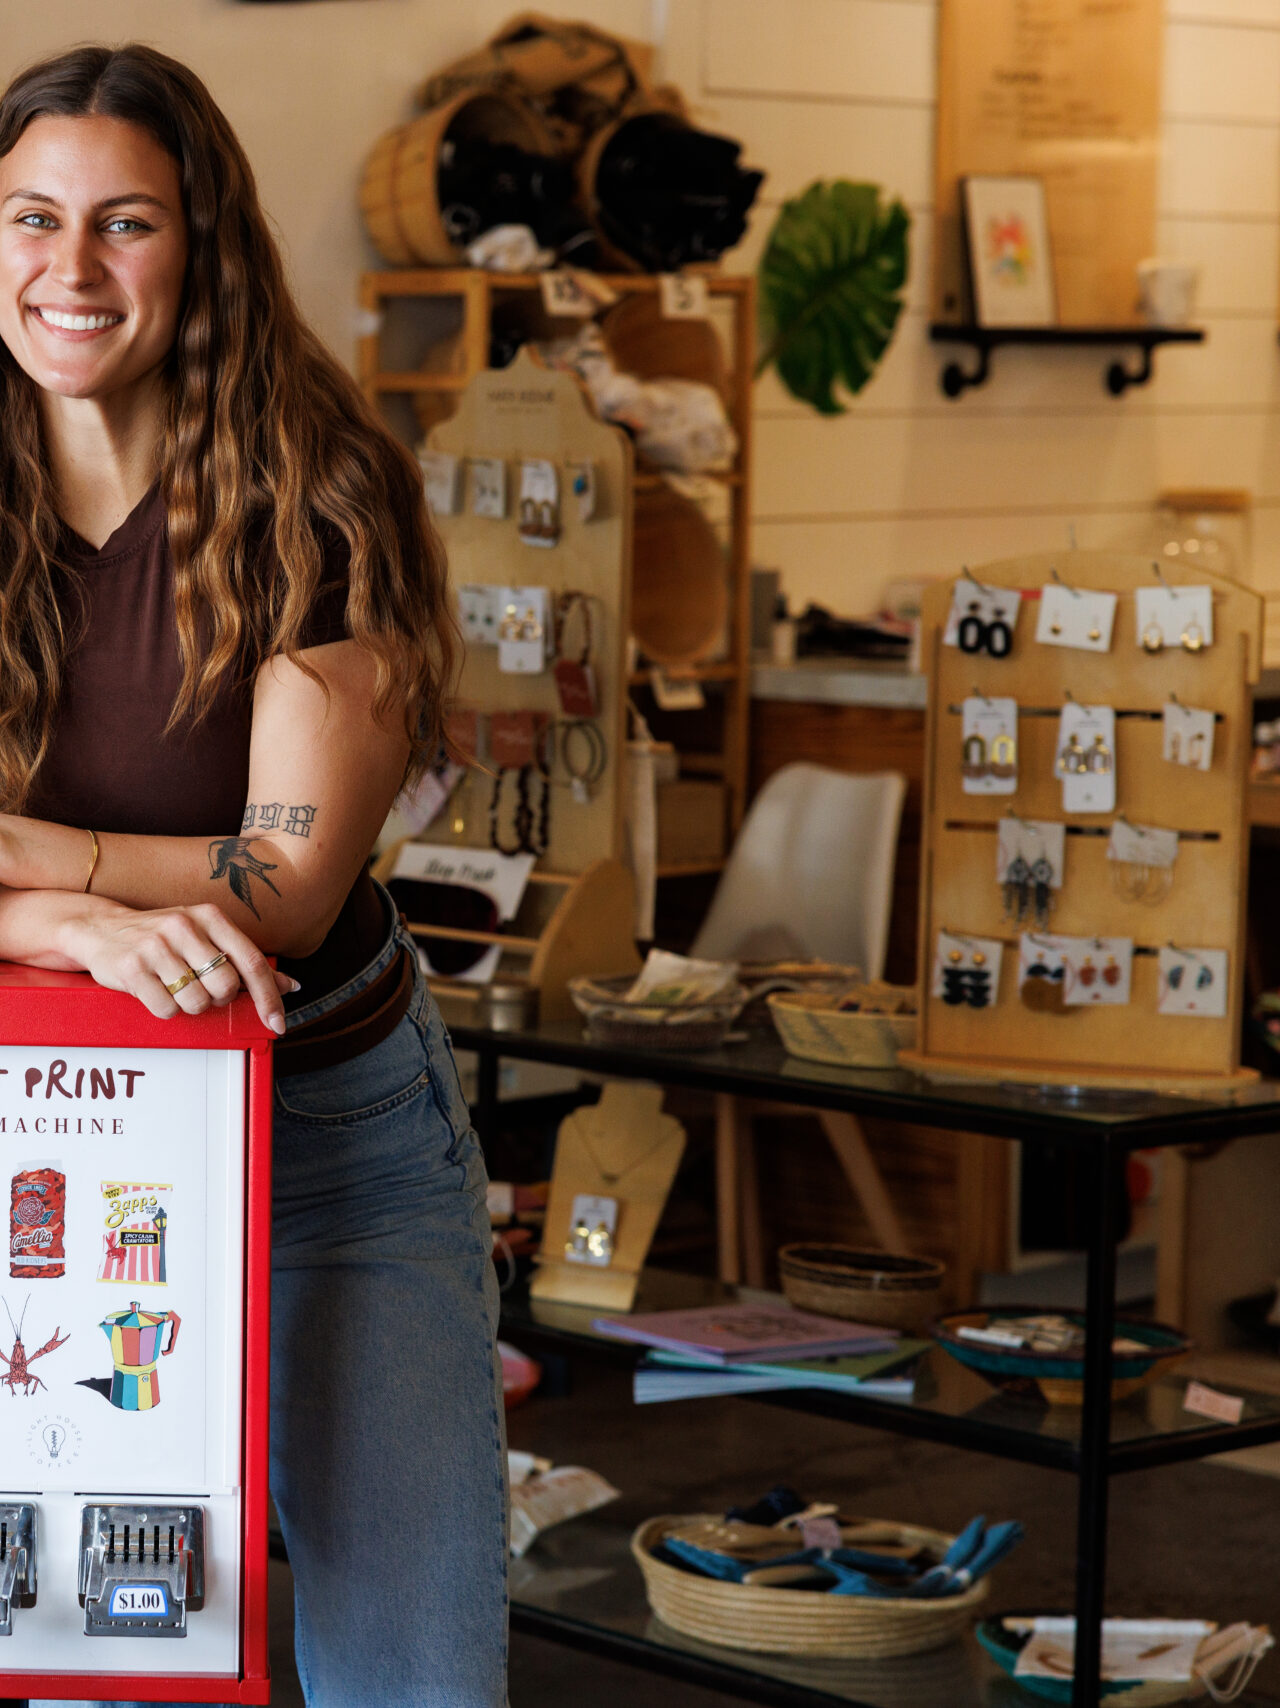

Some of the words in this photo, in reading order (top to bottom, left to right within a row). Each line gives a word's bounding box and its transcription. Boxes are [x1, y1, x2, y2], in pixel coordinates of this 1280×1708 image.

[25, 1059, 146, 1100] PRINT
[12, 1228, 53, 1253] Camellia
[118, 1592, 161, 1610] $1.00
